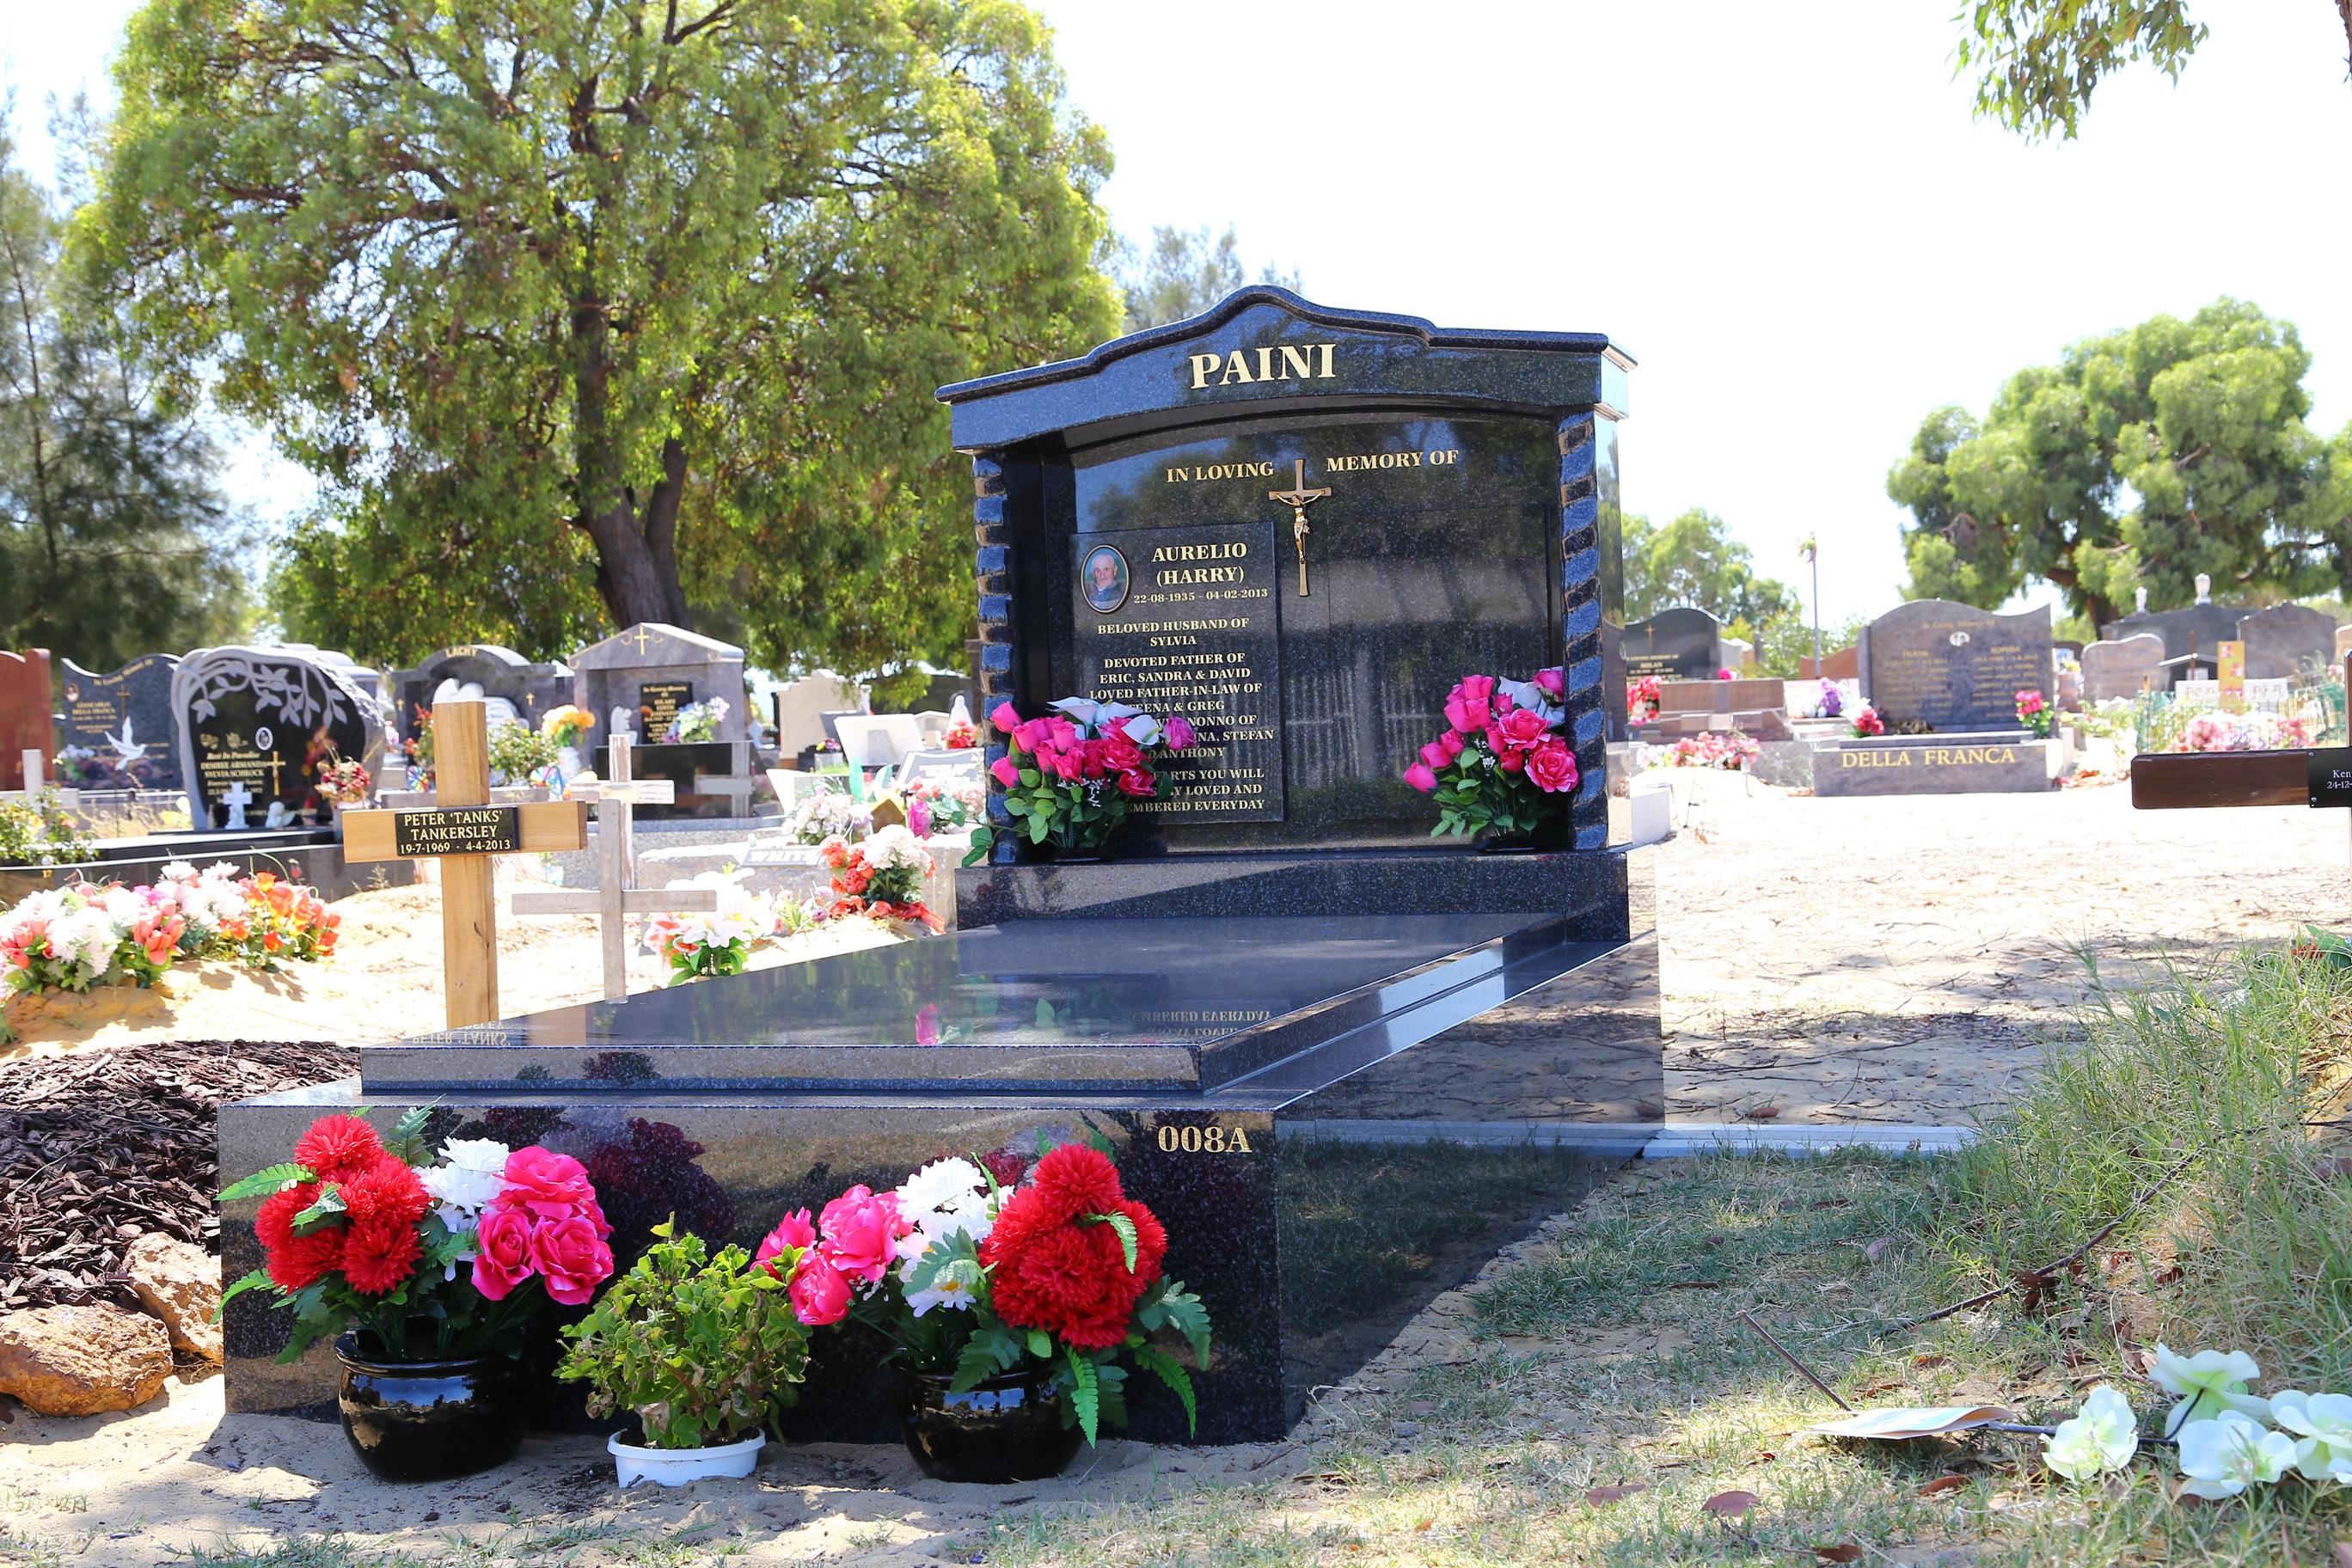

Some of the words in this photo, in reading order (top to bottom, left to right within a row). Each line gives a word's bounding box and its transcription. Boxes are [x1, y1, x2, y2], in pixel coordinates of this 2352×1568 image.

[1188, 344, 1337, 389] PAINI
[1167, 468, 1189, 483] IN
[1196, 462, 1275, 481] LOVING
[1326, 451, 1424, 472] MEMORY
[1430, 449, 1459, 465] OF
[1152, 542, 1247, 562] AURELIO
[1156, 566, 1245, 587] (HARRY)
[1134, 592, 1195, 603] 22-08-1935
[1206, 588, 1268, 600] 04-02-2013
[1098, 622, 1159, 634] BELOVED
[1163, 619, 1228, 631] HUSBAND
[1231, 618, 1249, 628] OF
[1150, 635, 1197, 646] SYLVIA
[1105, 656, 1167, 668] DEVOTED
[1171, 653, 1223, 665] FATHER
[1227, 652, 1245, 664] OF
[1099, 673, 1135, 684] ERIC,
[1138, 671, 1192, 683] SANDRA
[1195, 671, 1205, 680] &
[1210, 668, 1250, 679] DAVID
[1090, 689, 1133, 701] LOVED
[1137, 683, 1240, 698] FATHER-IN-LAW
[1244, 683, 1262, 693] OF
[1173, 701, 1184, 712] &
[1187, 701, 1225, 712] GREG
[1187, 716, 1235, 726] NONNO
[1239, 715, 1257, 725] OF
[1222, 730, 1274, 741] STEFAN
[1159, 747, 1226, 759] ANTHONY
[1841, 750, 1911, 768] DELLA
[1924, 748, 2016, 765] FRANCA
[1198, 769, 1226, 780] YOU
[1229, 768, 1265, 779] WILL
[1186, 784, 1230, 796] LOVED
[1234, 783, 1262, 794] AND
[1195, 799, 1265, 811] EVERYDAY
[404, 812, 445, 826] PETER
[411, 825, 498, 841] TANKERSLEY
[401, 842, 450, 854] 19-7-1969
[465, 839, 511, 851] 4-4-2013
[1158, 1125, 1253, 1153] 008A
